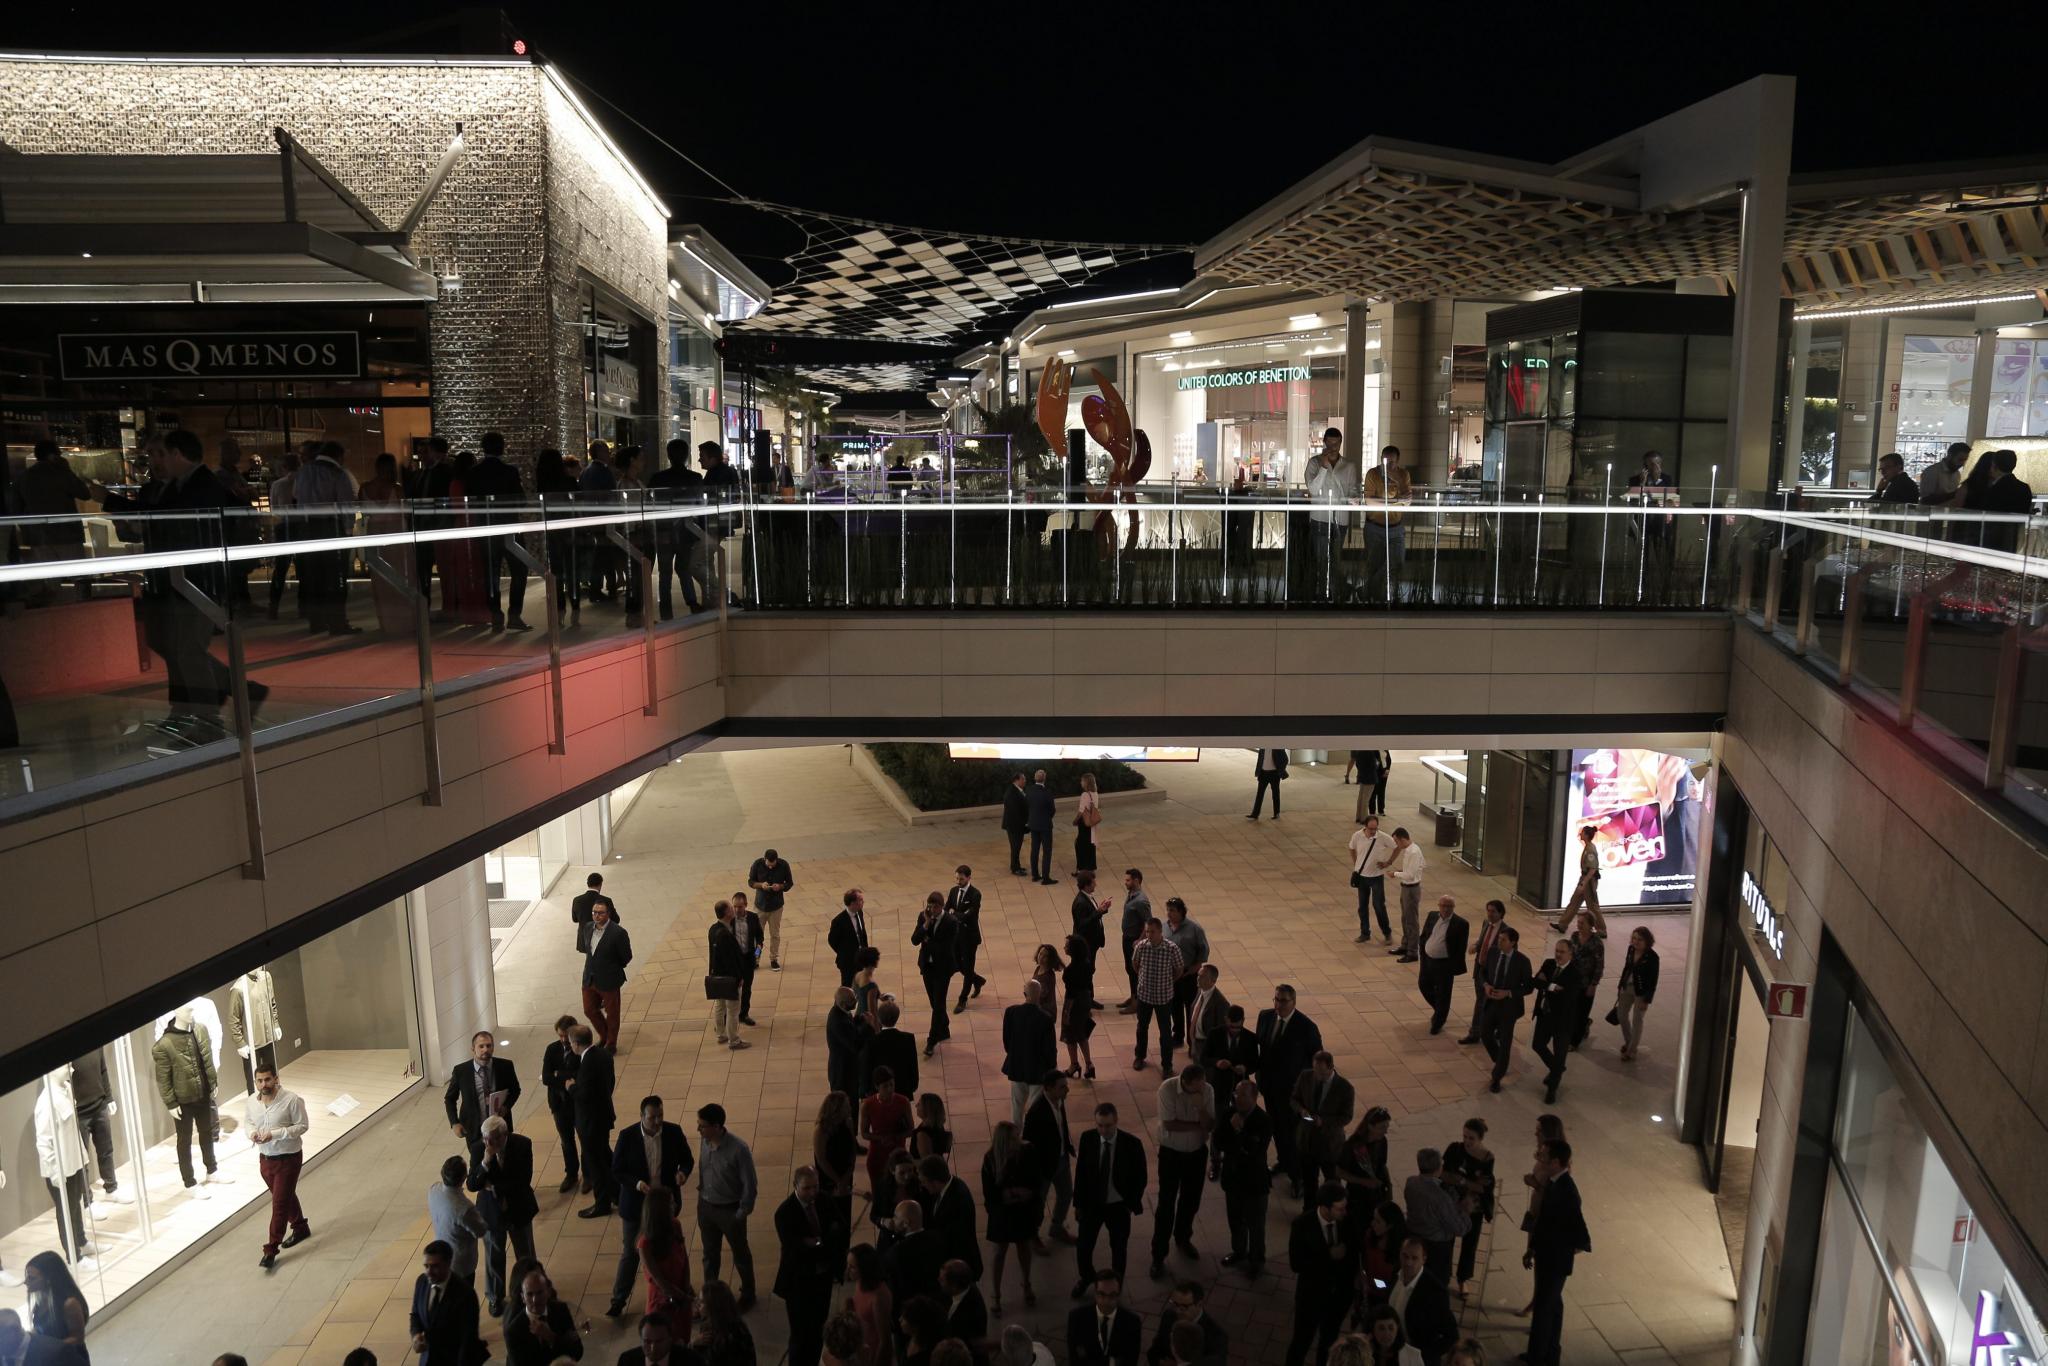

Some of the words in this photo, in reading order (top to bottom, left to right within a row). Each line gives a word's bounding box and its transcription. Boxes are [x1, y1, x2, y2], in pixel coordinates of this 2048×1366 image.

[1178, 375, 1207, 390] UNITED
[1208, 372, 1244, 388] COLORS
[1244, 370, 1257, 385] OF
[1742, 871, 1783, 960] RITUALS
